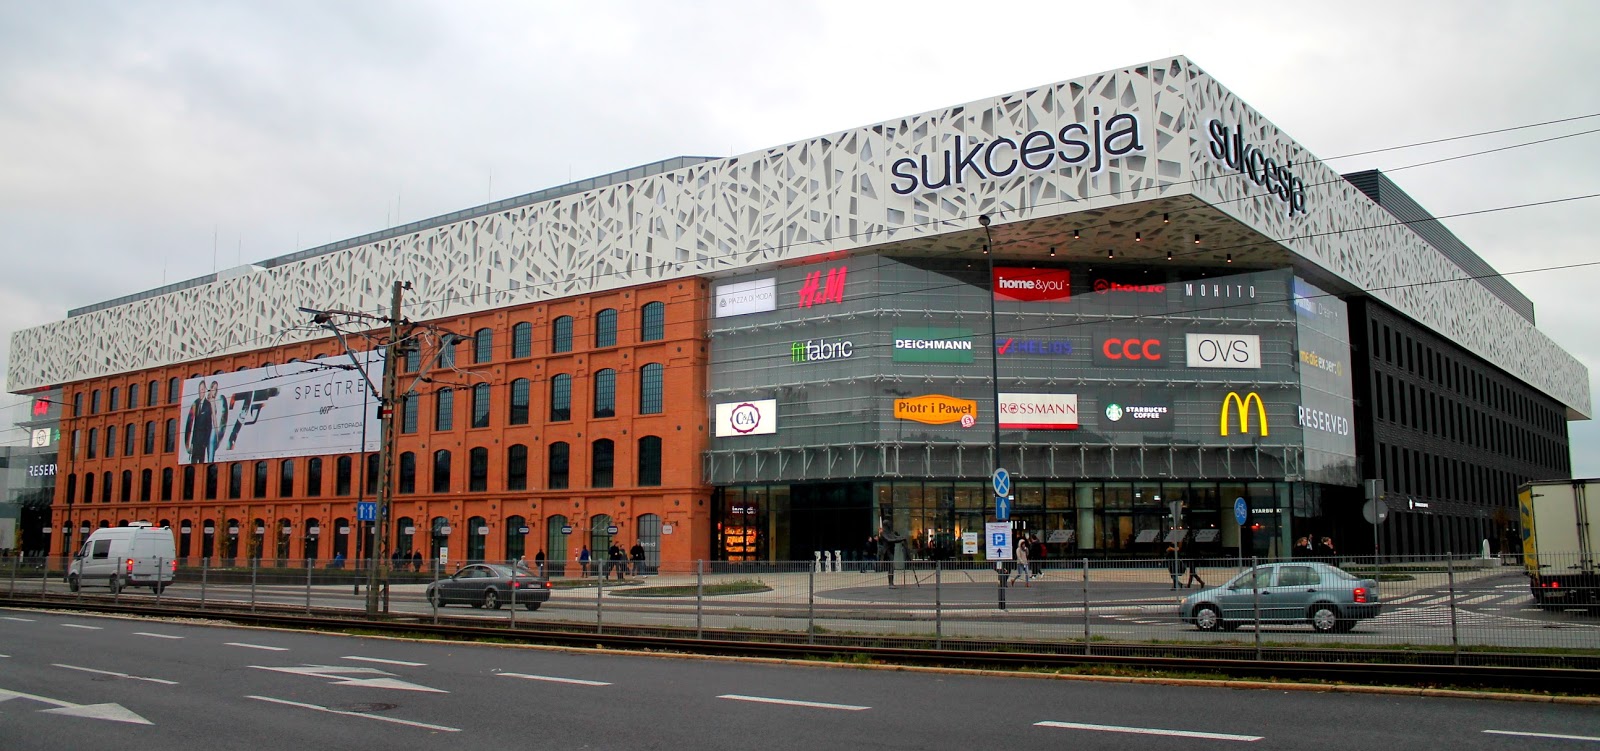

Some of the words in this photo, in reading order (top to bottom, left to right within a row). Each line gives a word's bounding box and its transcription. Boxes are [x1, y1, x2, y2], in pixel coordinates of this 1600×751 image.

[890, 106, 1144, 195] sukcesja
[1209, 119, 1306, 217] sukcesja
[798, 265, 848, 308] H&M
[999, 276, 1063, 292] home&you
[1185, 283, 1256, 298] MOHITO
[728, 296, 748, 305] PIAZZA
[748, 295, 754, 303] DI
[755, 292, 773, 301] MODA
[1103, 338, 1161, 360] CCC
[1198, 339, 1249, 362] OVS
[294, 379, 364, 400] SPECTRE
[898, 402, 928, 413] Piotr
[931, 402, 935, 413] i
[938, 402, 972, 414] Paweł
[1000, 403, 1076, 415] ROSSMANN
[333, 421, 363, 430] LISTOPADA
[735, 411, 756, 425] C&A
[1298, 406, 1349, 436] RESERVED
